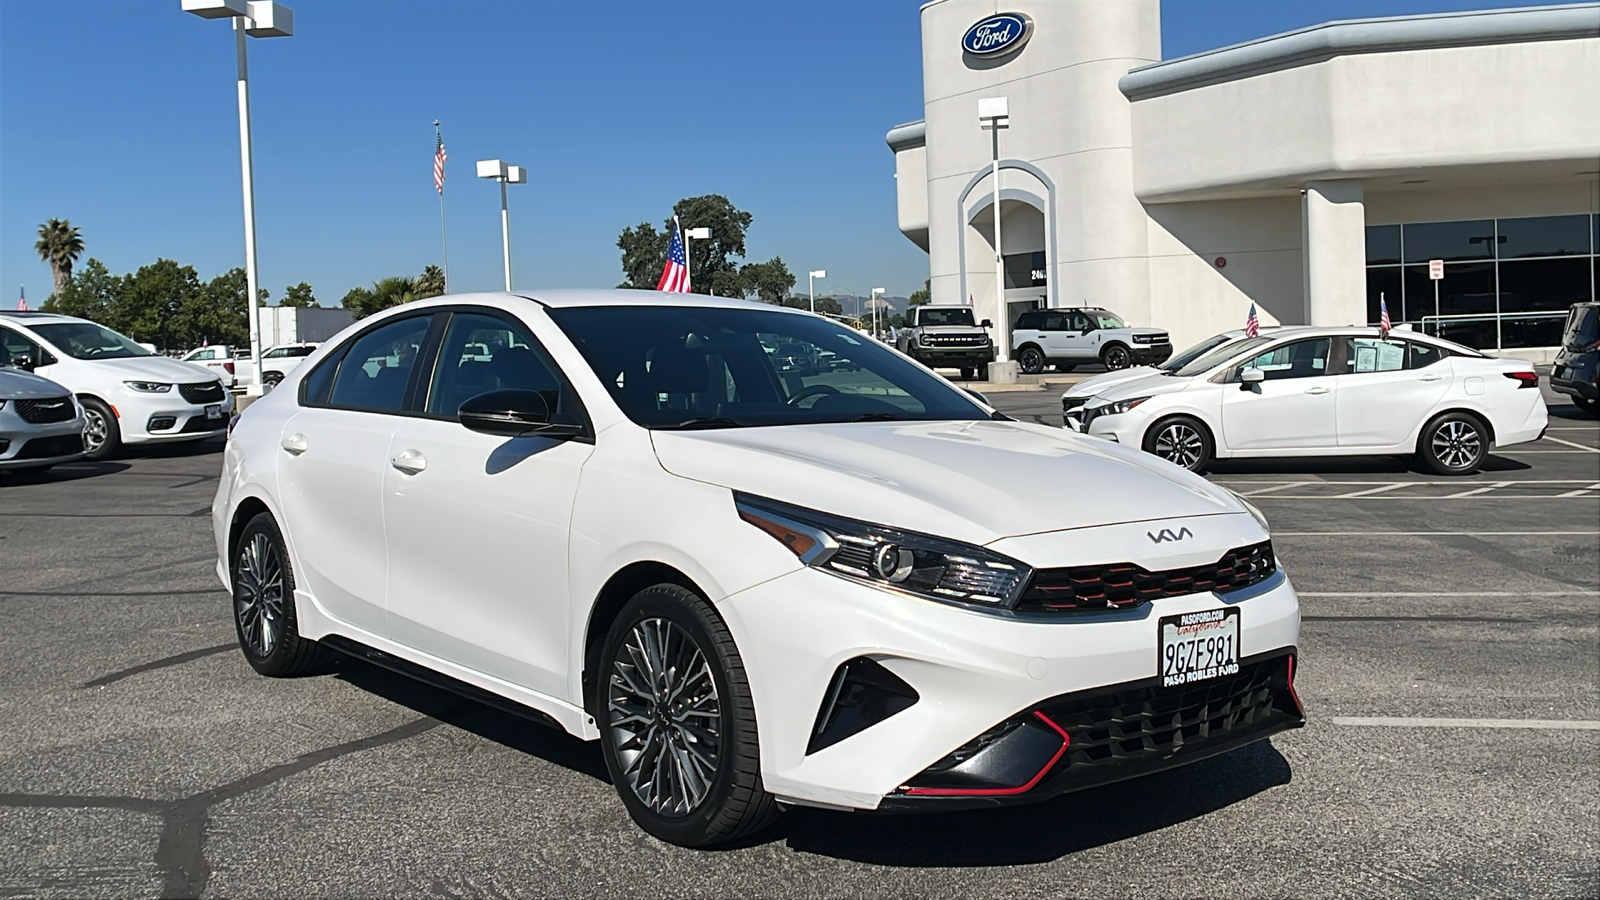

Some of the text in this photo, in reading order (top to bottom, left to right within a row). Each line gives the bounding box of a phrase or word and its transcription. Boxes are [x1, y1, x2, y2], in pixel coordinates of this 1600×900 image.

[973, 21, 1011, 49] Ford
[1147, 527, 1193, 544] KIA
[1181, 609, 1224, 625] PASOFORD.COM
[1165, 634, 1234, 677] 9GZF981
[1164, 663, 1240, 687] PASO ROBLES FORD
